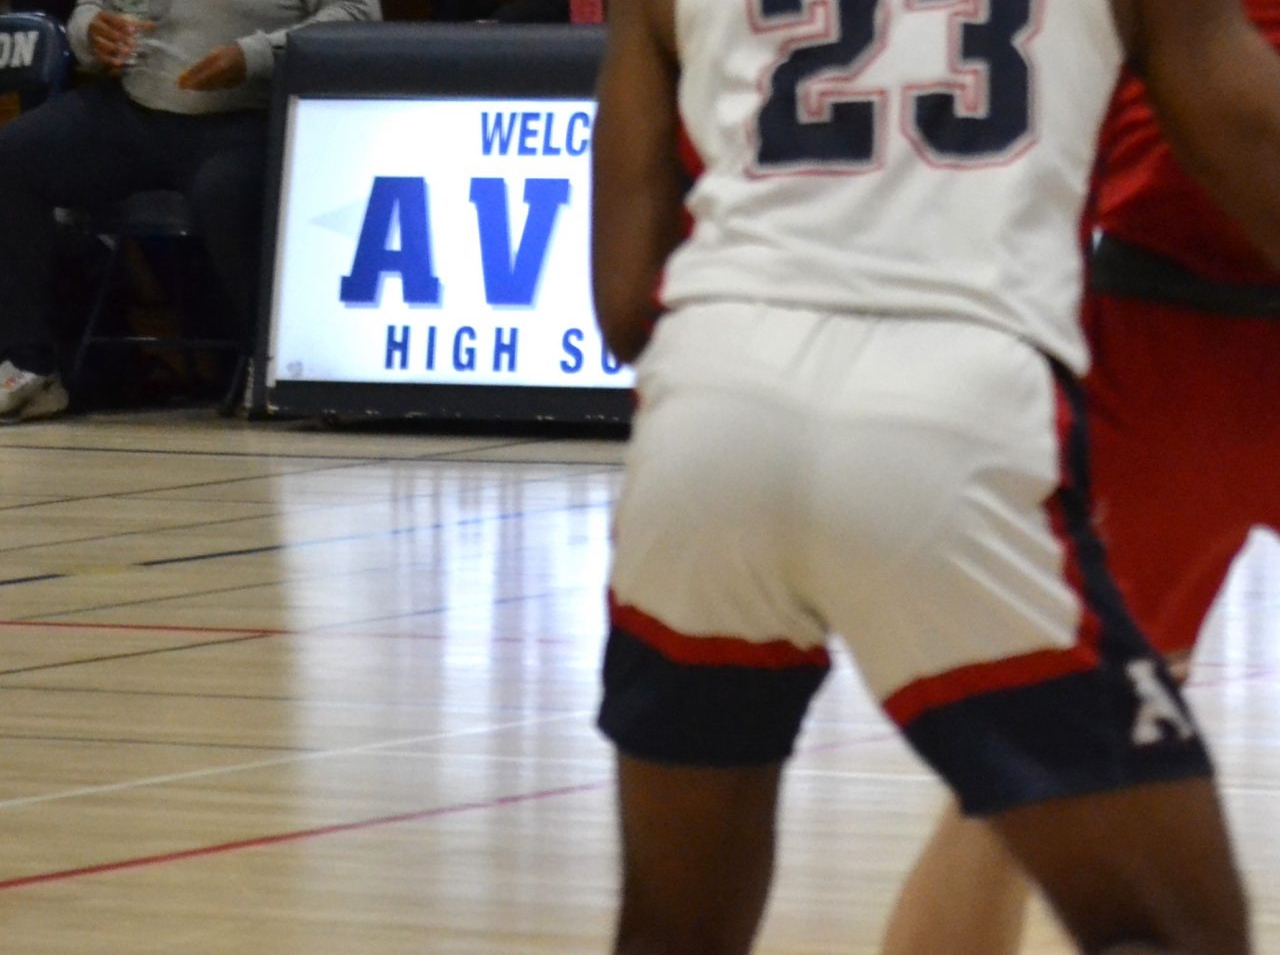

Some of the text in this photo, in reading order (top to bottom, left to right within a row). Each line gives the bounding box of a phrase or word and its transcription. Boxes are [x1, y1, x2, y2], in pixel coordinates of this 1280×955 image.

[481, 111, 590, 156] WELC
[339, 176, 571, 307] AV
[385, 325, 519, 372] HIGH
[1126, 659, 1193, 744] A
